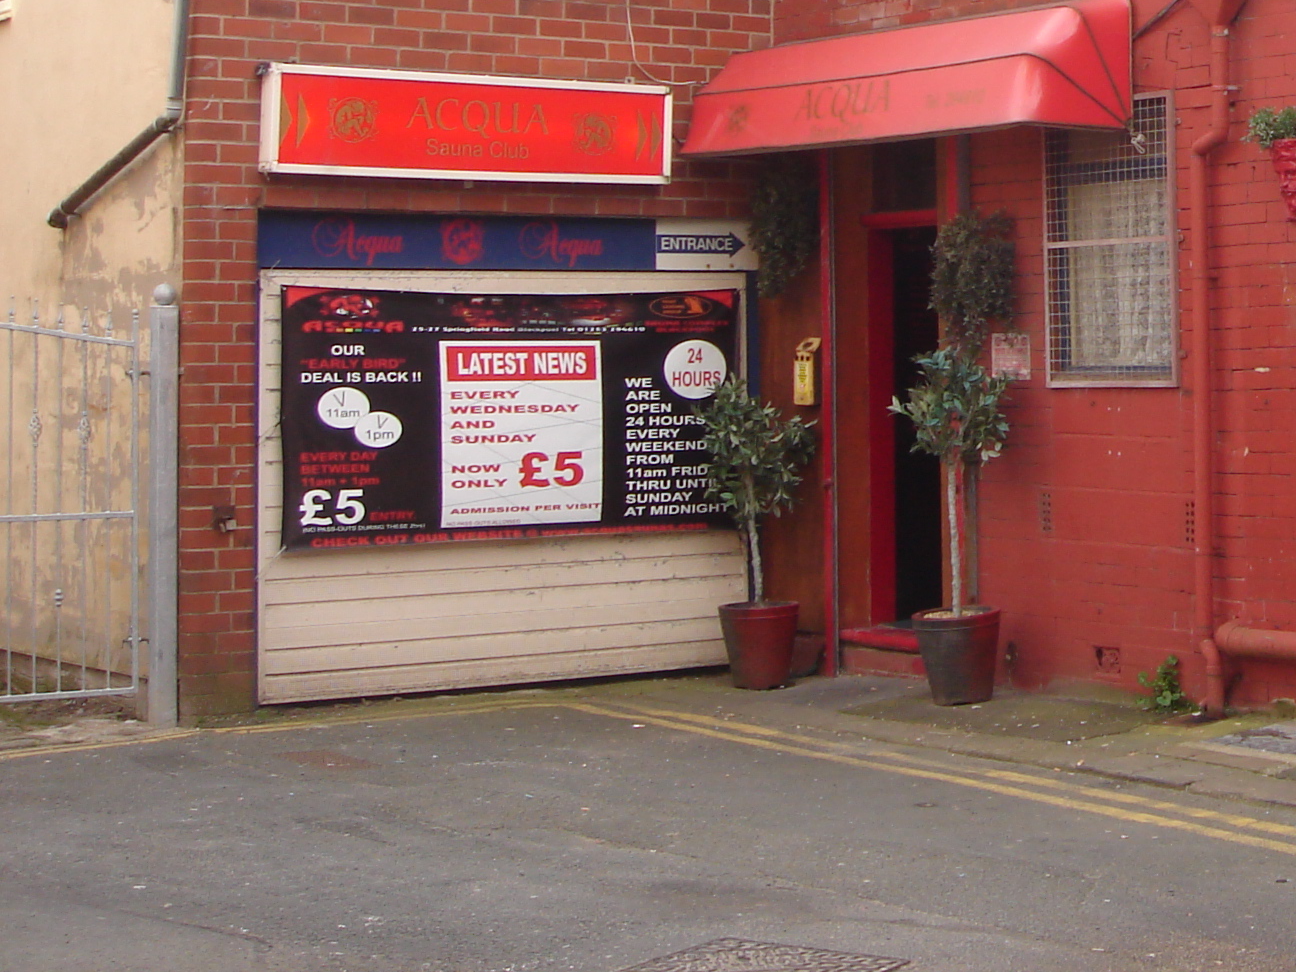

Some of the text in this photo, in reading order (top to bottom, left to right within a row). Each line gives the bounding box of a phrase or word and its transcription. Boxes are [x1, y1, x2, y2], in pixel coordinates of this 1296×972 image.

[795, 80, 891, 124] ACQUA
[405, 96, 550, 137] ACQUA
[425, 138, 530, 160] Sauna Club
[312, 218, 404, 266] Acqua
[518, 220, 604, 267] Acqua
[660, 236, 734, 252] ENTRANCE
[331, 345, 366, 356] OUR
[687, 348, 703, 364] 24
[457, 351, 587, 375] LATEST NEWS
[301, 372, 343, 384] DEAL
[347, 372, 362, 383] IS
[365, 372, 409, 383] BACK
[625, 377, 653, 388] WE
[672, 370, 722, 387] HOURS
[450, 390, 520, 400] EVERY
[625, 390, 661, 401] ARE
[326, 409, 360, 419] 11am
[450, 404, 579, 414] WEDNESDAY
[625, 403, 672, 414] OPEN
[450, 420, 495, 430] AND
[625, 415, 706, 427] 24 HOURS
[365, 430, 395, 442] 1pm
[450, 434, 537, 444] SUNDAY
[626, 428, 680, 440] EVERY
[625, 440, 708, 453] WEEKEND
[300, 451, 378, 462] EVERY DAY
[626, 454, 675, 466] FROM
[300, 464, 370, 475] BETWEEN
[451, 464, 501, 474] NOW
[518, 451, 585, 489] £5
[626, 467, 667, 479] 11am
[451, 478, 508, 489] ONLY
[625, 479, 671, 491] THRU
[625, 491, 693, 504] SUNDAY
[299, 488, 366, 526] £5
[450, 502, 601, 515] ADMISSION PER VISIT
[623, 503, 729, 518] AT MIDNIGHT
